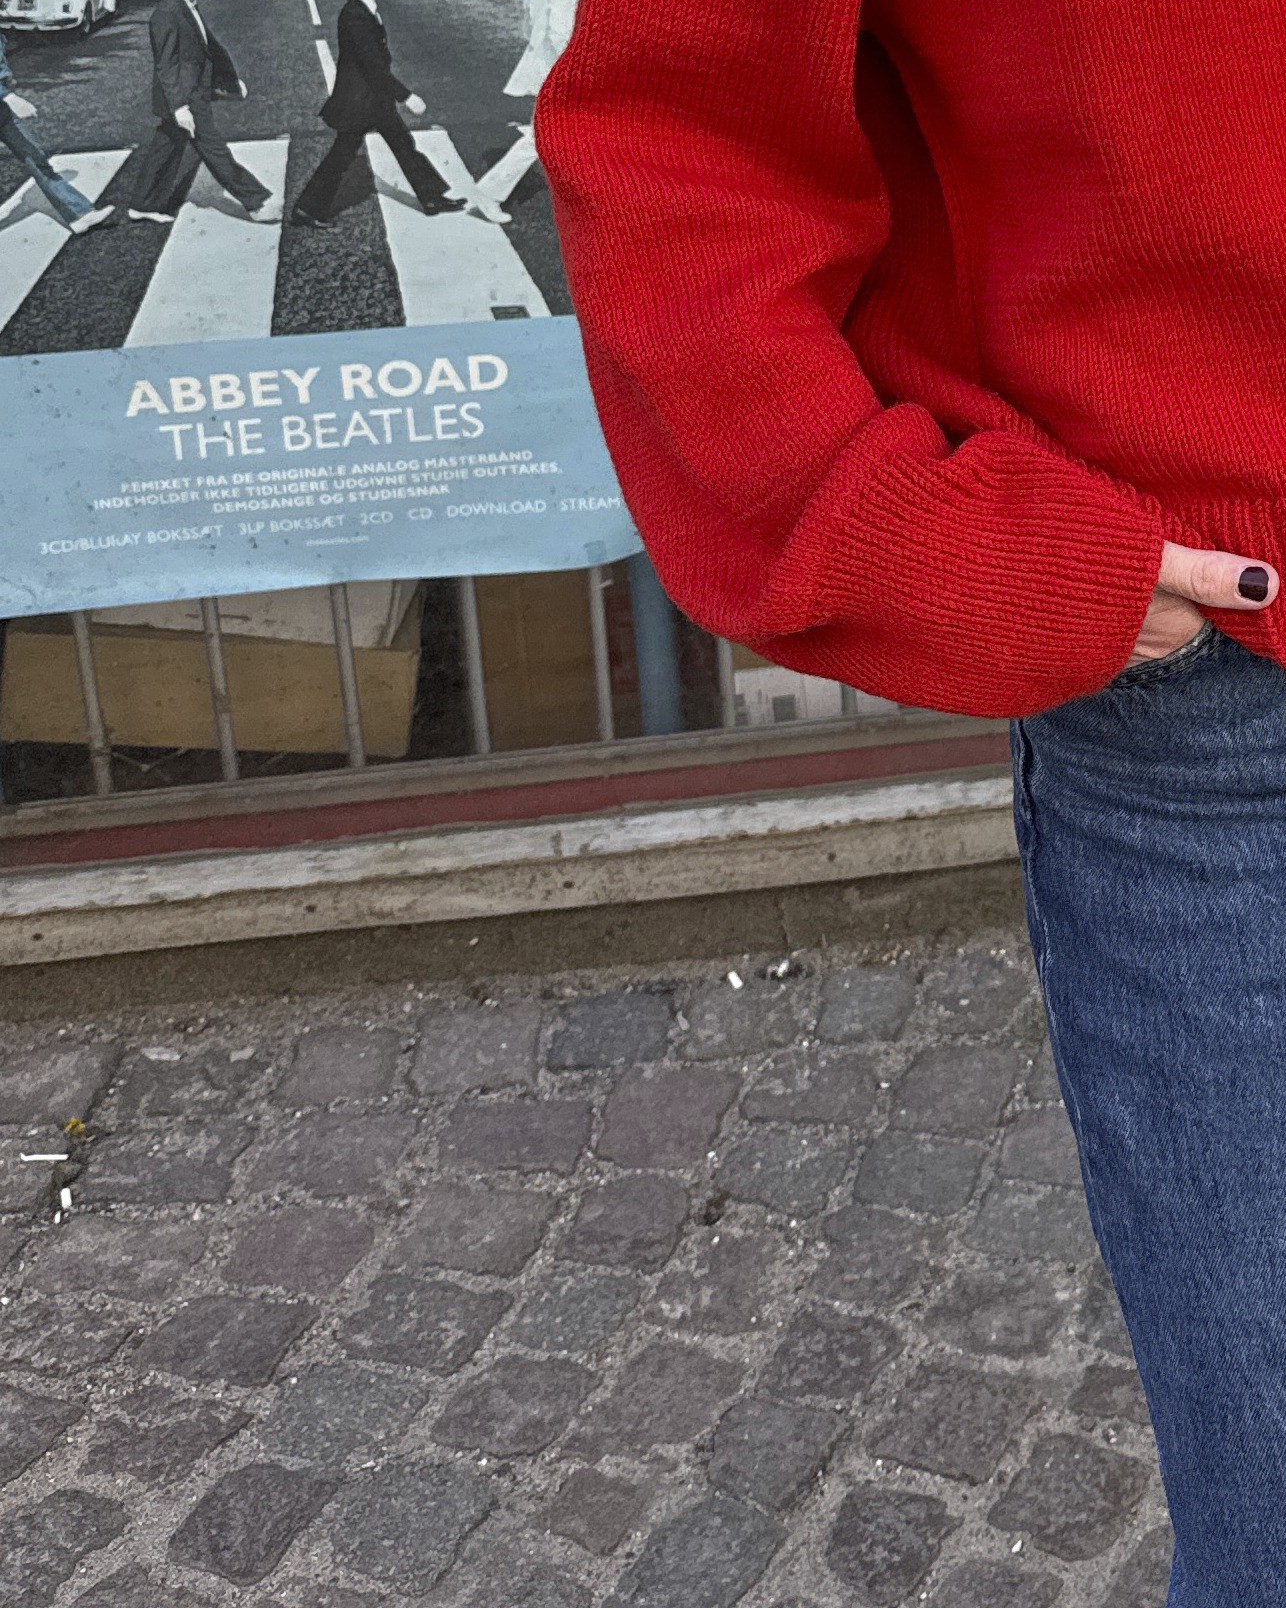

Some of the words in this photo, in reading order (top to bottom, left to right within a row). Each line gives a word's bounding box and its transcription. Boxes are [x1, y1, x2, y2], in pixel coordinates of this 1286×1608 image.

[125, 366, 321, 418] ABBEY
[341, 353, 510, 401] ROAD
[159, 418, 266, 461] THE
[282, 402, 486, 451] BEATLES
[204, 487, 240, 501] IKKE
[244, 480, 329, 497] TIDLIGERE
[410, 468, 469, 483] STUDIE
[232, 472, 254, 486] DE
[257, 465, 347, 483] ORIGINALE
[351, 459, 420, 475] ANALOG
[424, 449, 534, 470] MASTERBAND
[212, 494, 316, 513] DEMOSANGE
[319, 493, 345, 506] OG
[348, 483, 450, 504] STUDIESNAK
[359, 510, 394, 526] 2CD
[407, 506, 433, 520] CD
[446, 499, 547, 519] DOWNLOAD
